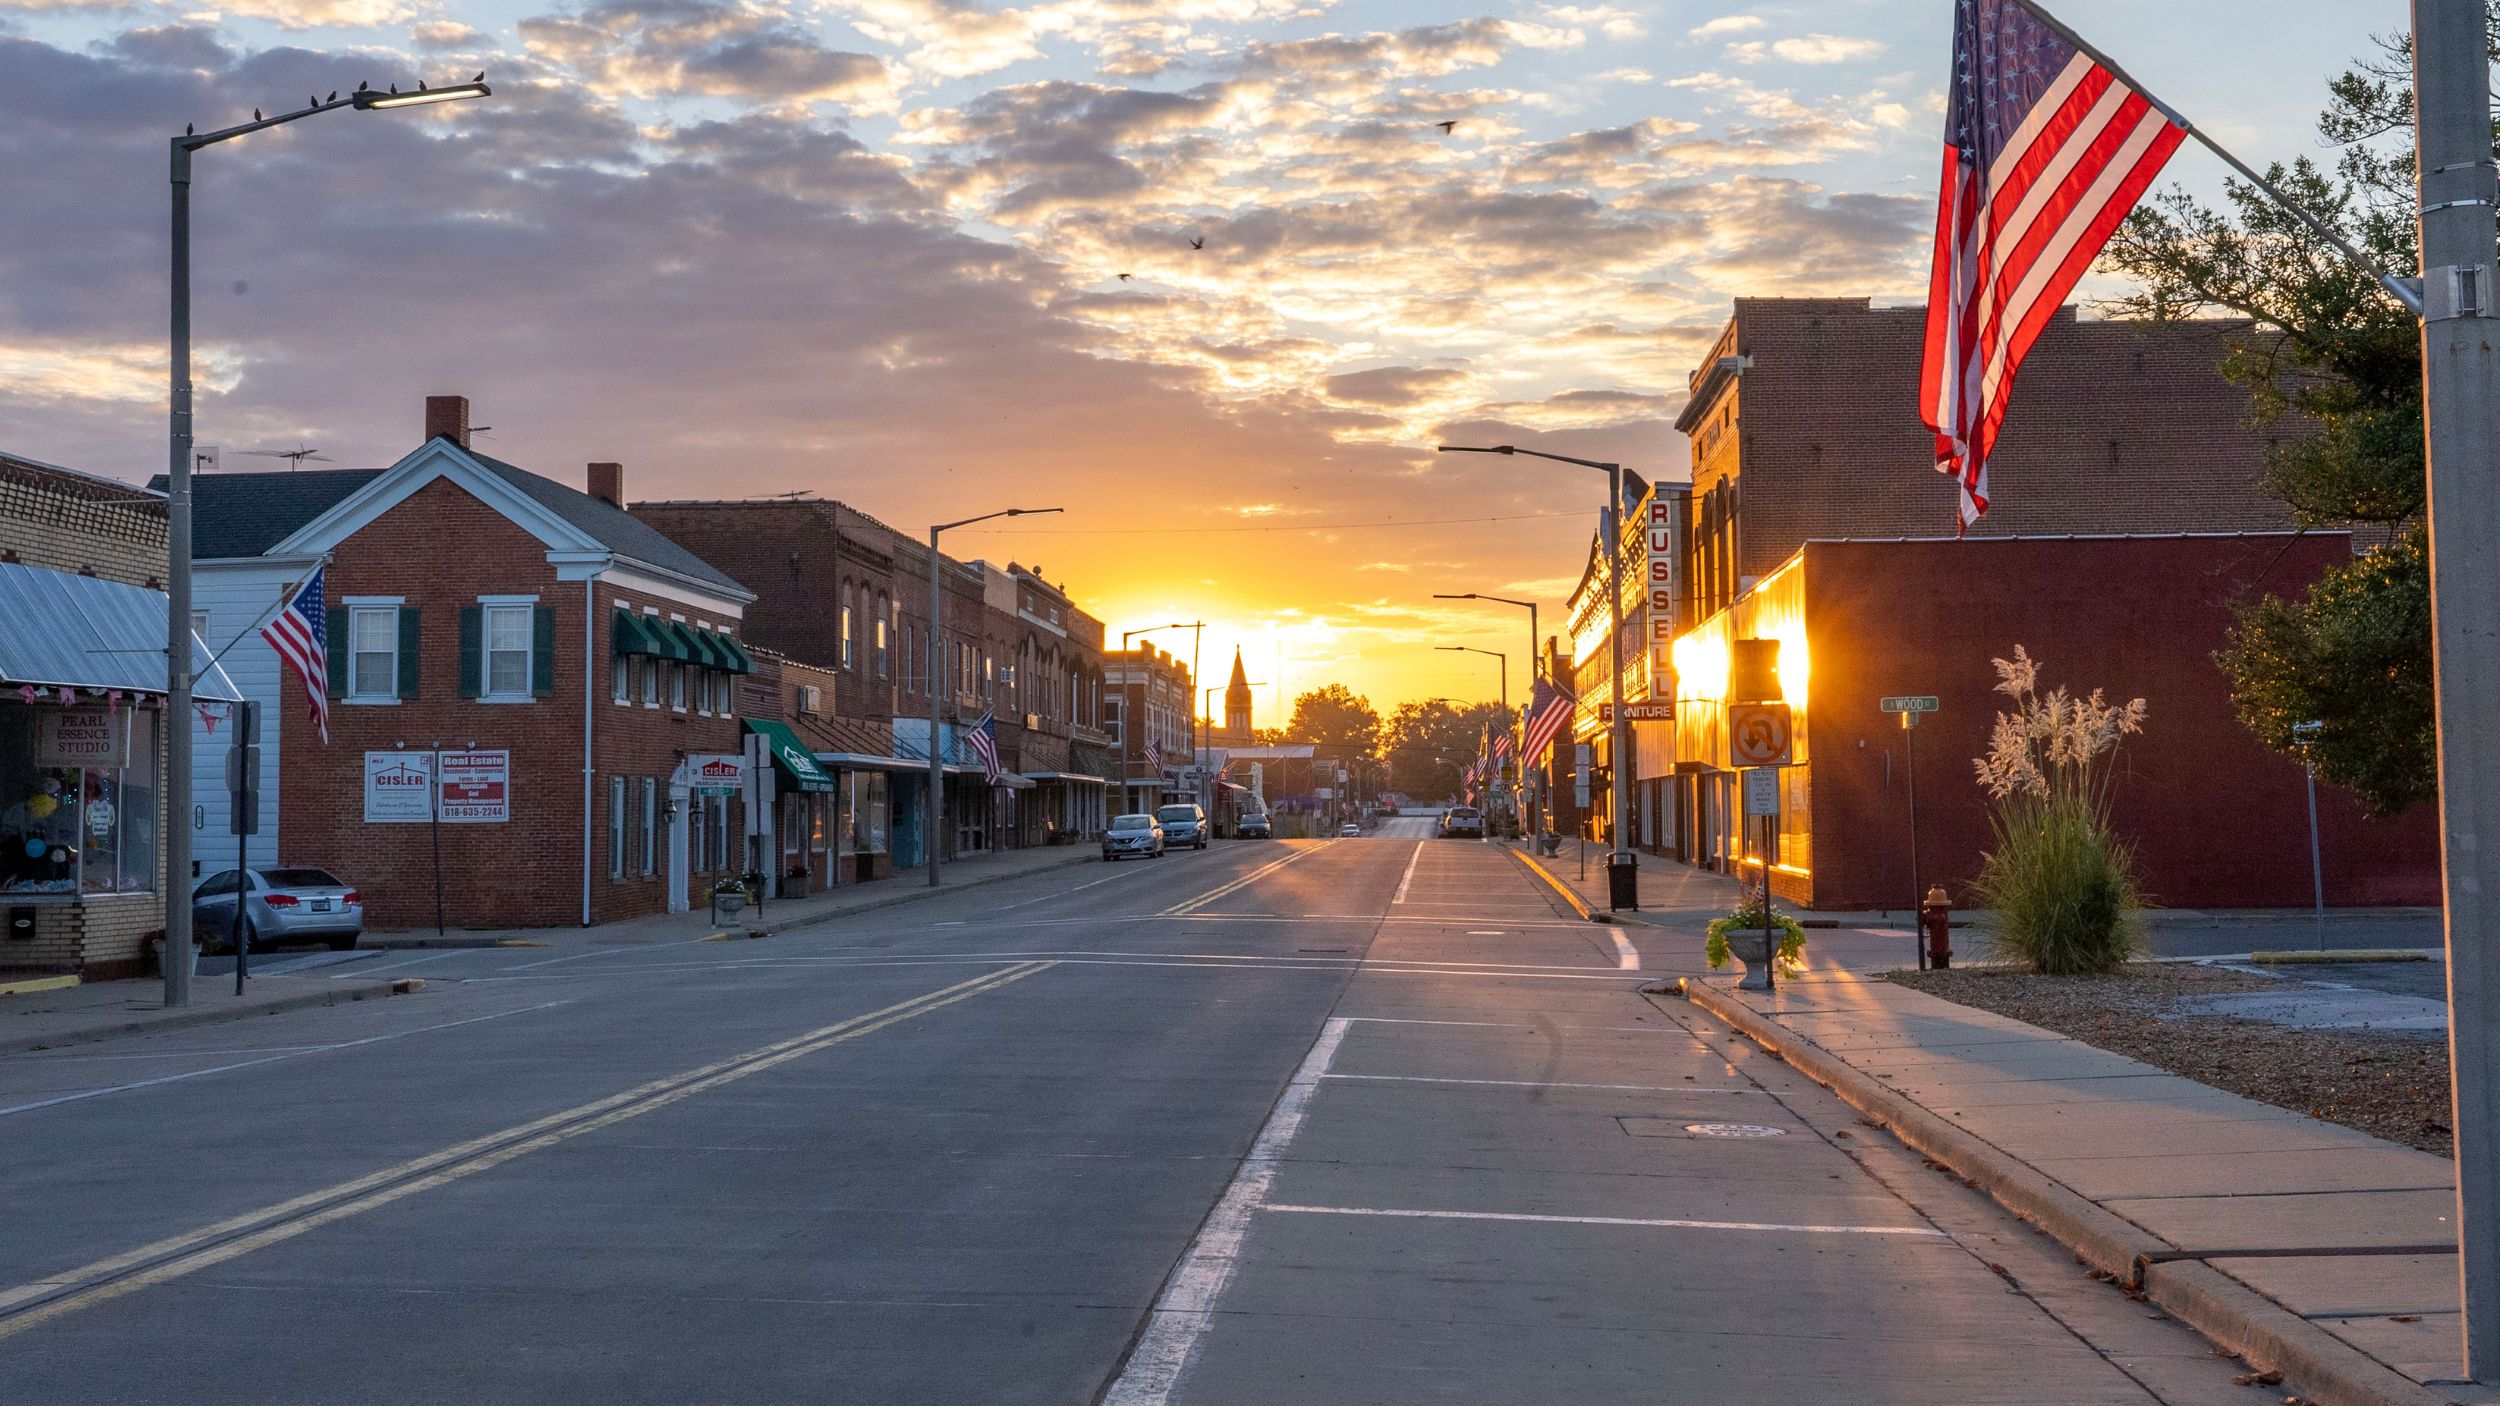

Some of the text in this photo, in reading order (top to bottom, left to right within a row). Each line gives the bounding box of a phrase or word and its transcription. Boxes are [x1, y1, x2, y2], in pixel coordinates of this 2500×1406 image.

[1651, 504, 1669, 697] RUSSELL
[1896, 698, 1923, 710] WOOD
[1604, 706, 1670, 718] FNITURE
[61, 715, 106, 727] PEARL
[57, 729, 110, 740] ESSENCE
[58, 741, 111, 753] STUDIO
[444, 756, 503, 765] Real Estate
[444, 807, 503, 817] 618-635-2244
